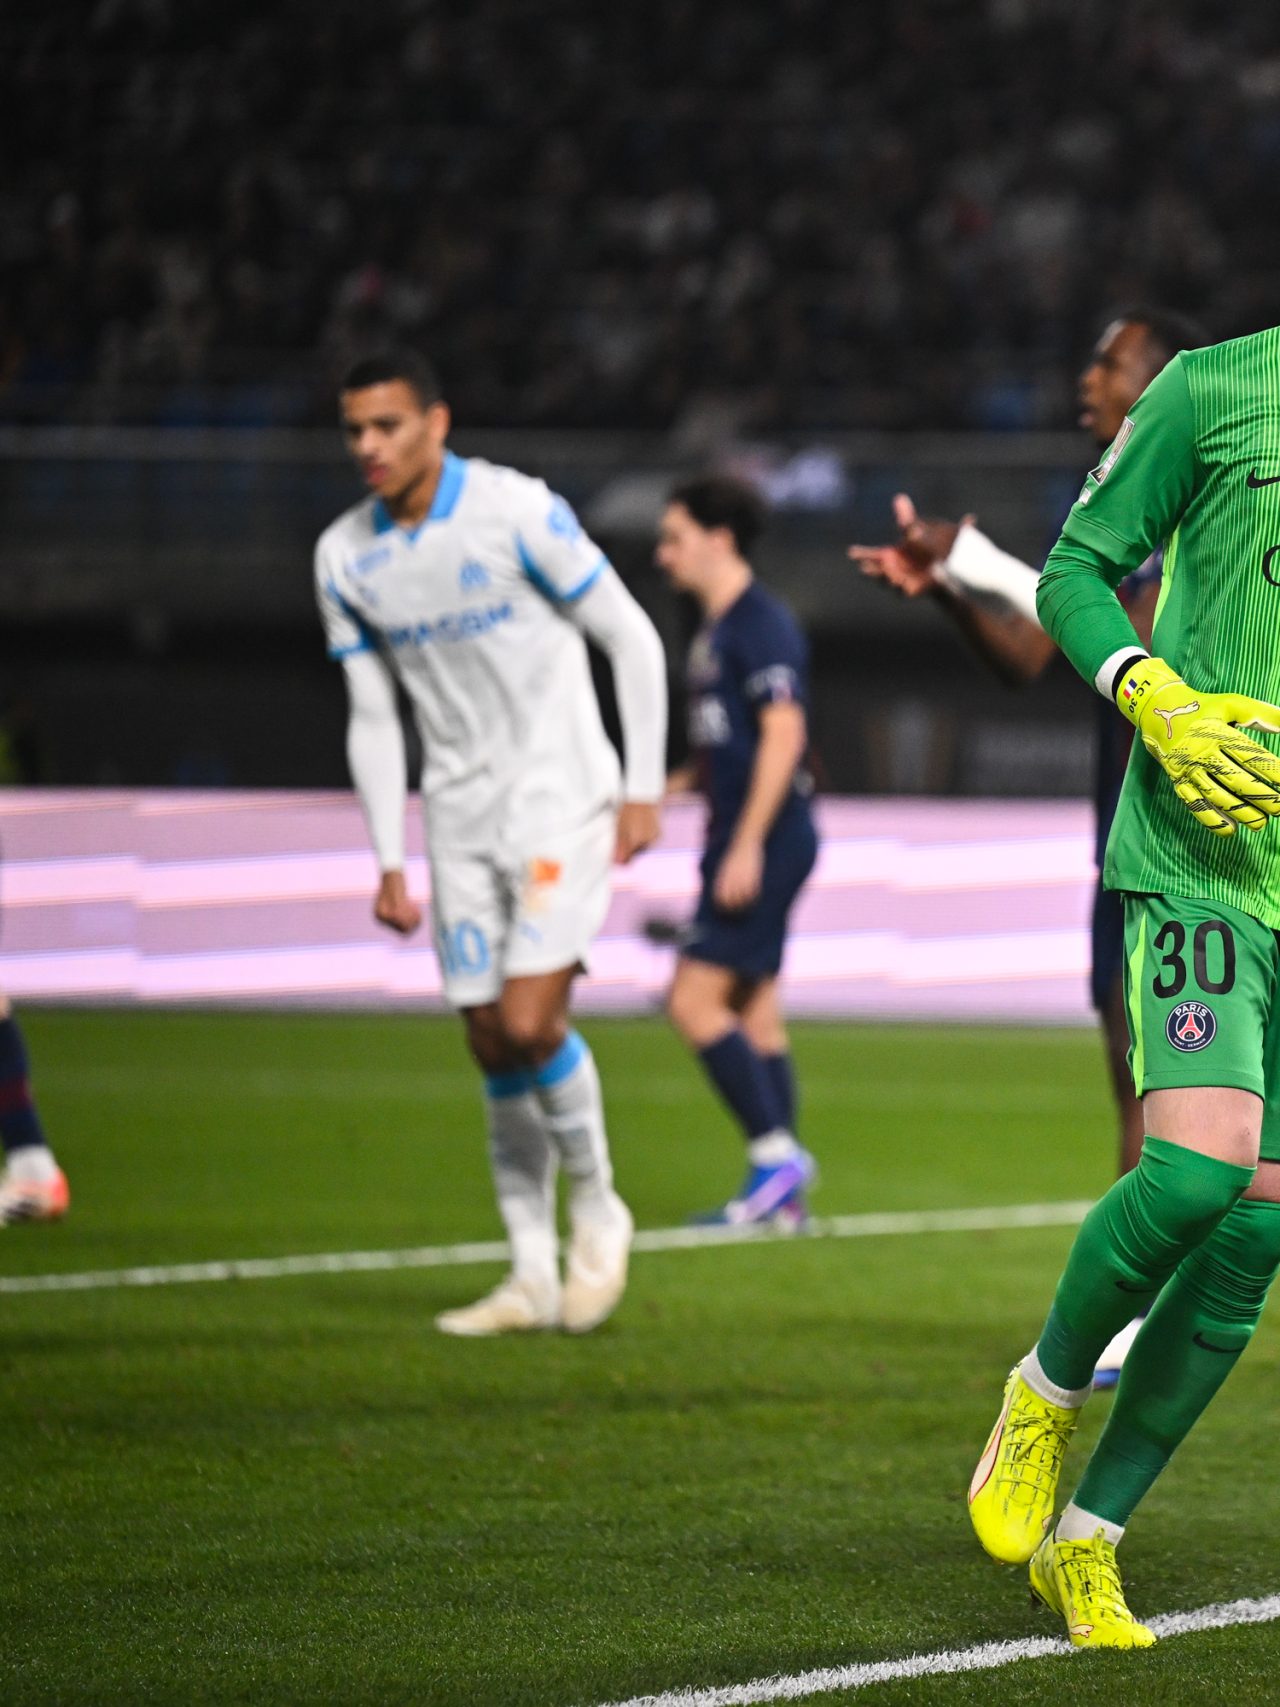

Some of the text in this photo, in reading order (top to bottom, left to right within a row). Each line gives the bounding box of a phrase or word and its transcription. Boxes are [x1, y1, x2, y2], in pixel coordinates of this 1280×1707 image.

[1136, 679, 1151, 697] LC
[1152, 919, 1236, 999] 30
[1174, 1003, 1208, 1017] PARIS
